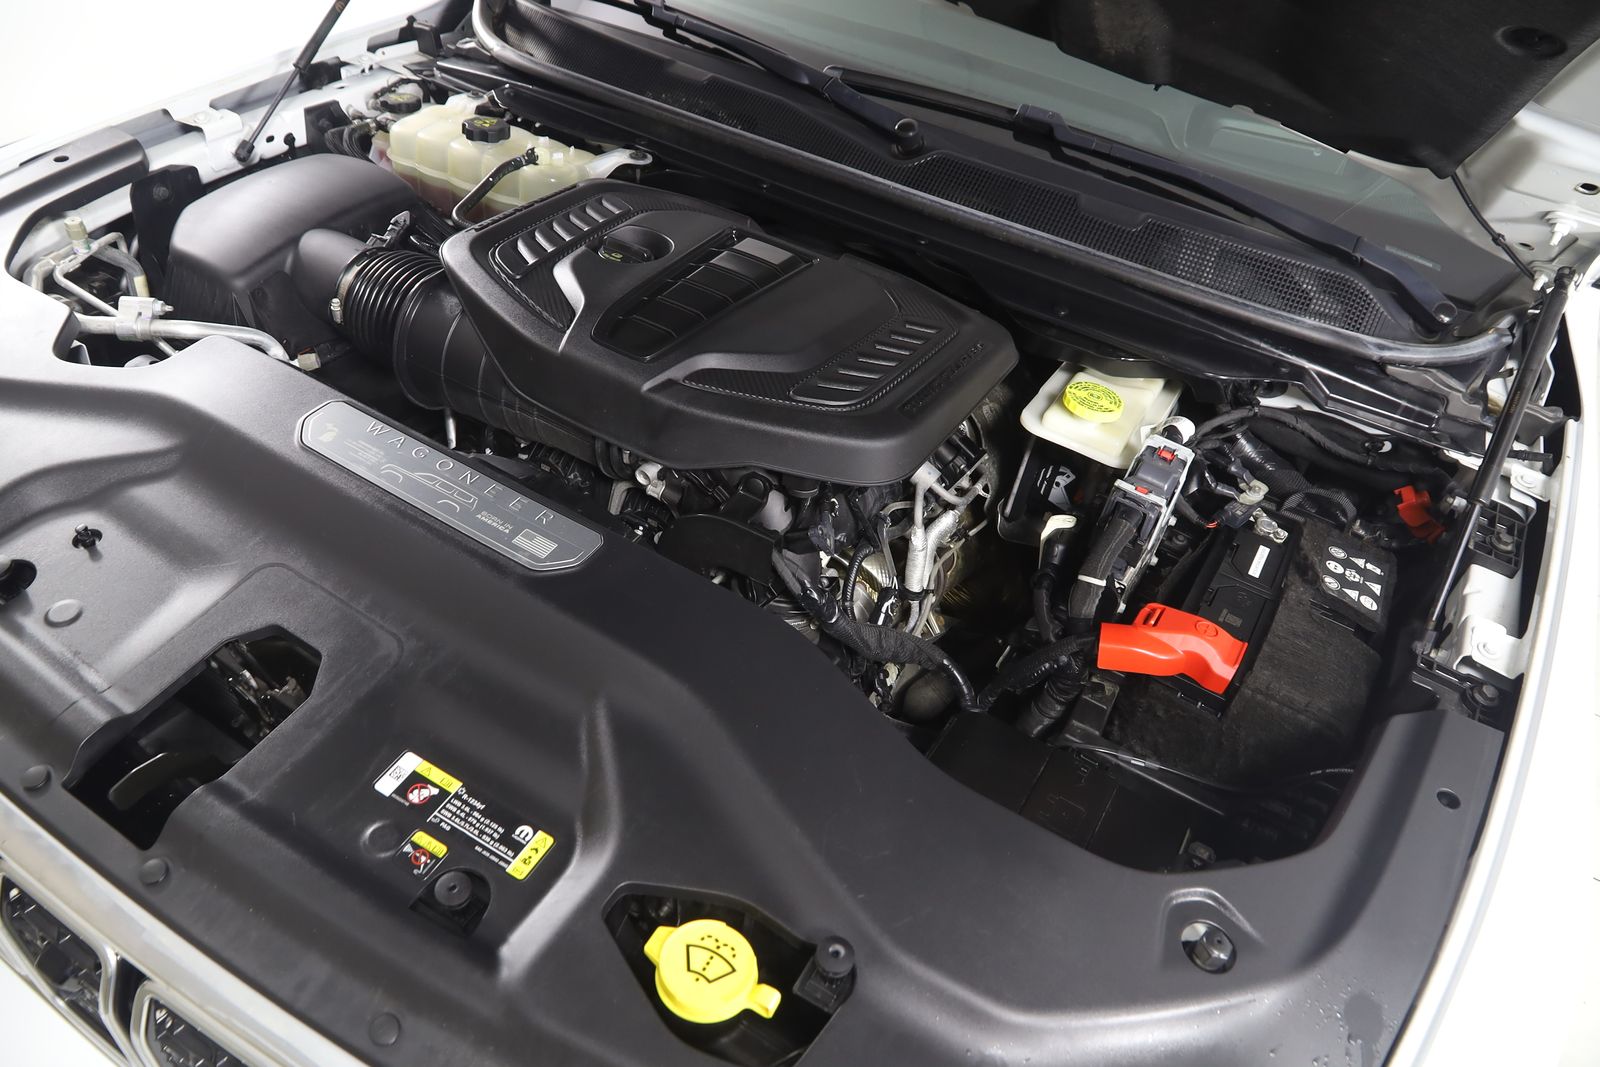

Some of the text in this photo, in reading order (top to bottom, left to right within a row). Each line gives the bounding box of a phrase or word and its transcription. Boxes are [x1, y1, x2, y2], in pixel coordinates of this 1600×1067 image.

[364, 420, 554, 525] WAGONEER
[476, 514, 510, 534] AMERICA
[480, 510, 512, 530] BORN IN
